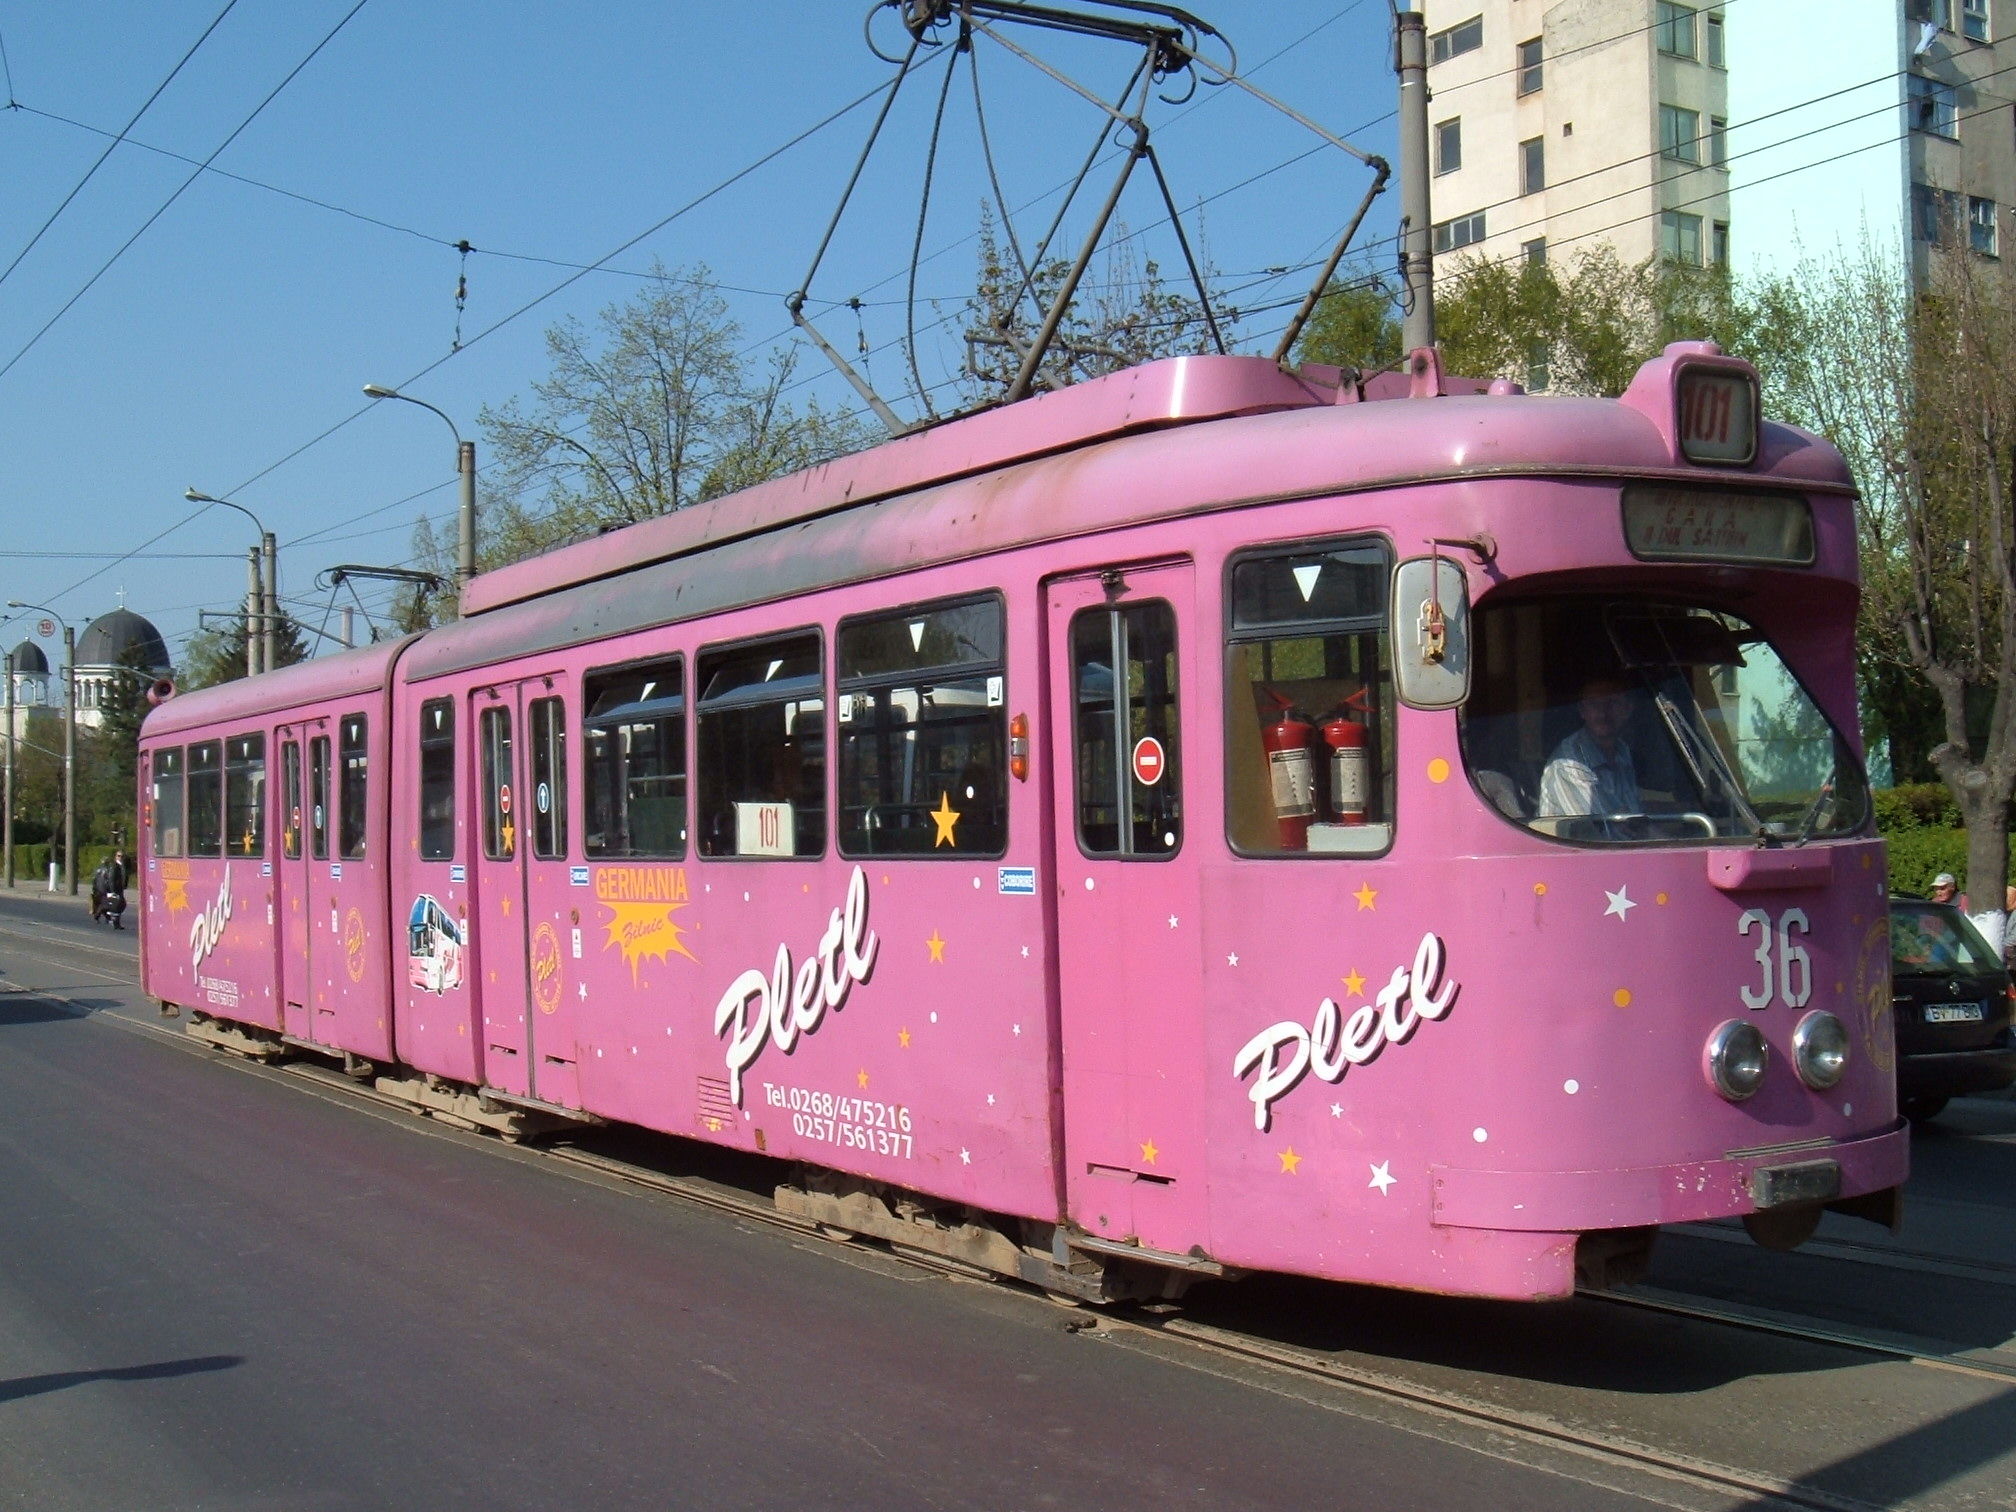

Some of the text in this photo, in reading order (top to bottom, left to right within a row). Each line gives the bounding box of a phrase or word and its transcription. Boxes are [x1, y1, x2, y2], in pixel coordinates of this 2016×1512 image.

[1683, 383, 1732, 443] 101
[759, 807, 779, 849] 101
[189, 861, 233, 985] Pletl
[596, 867, 689, 900] GERMANIA
[714, 864, 879, 1109] Pletl
[1738, 908, 1812, 1010] 36
[1233, 932, 1461, 1134] Pletl
[793, 1113, 912, 1159] 0257/561377
